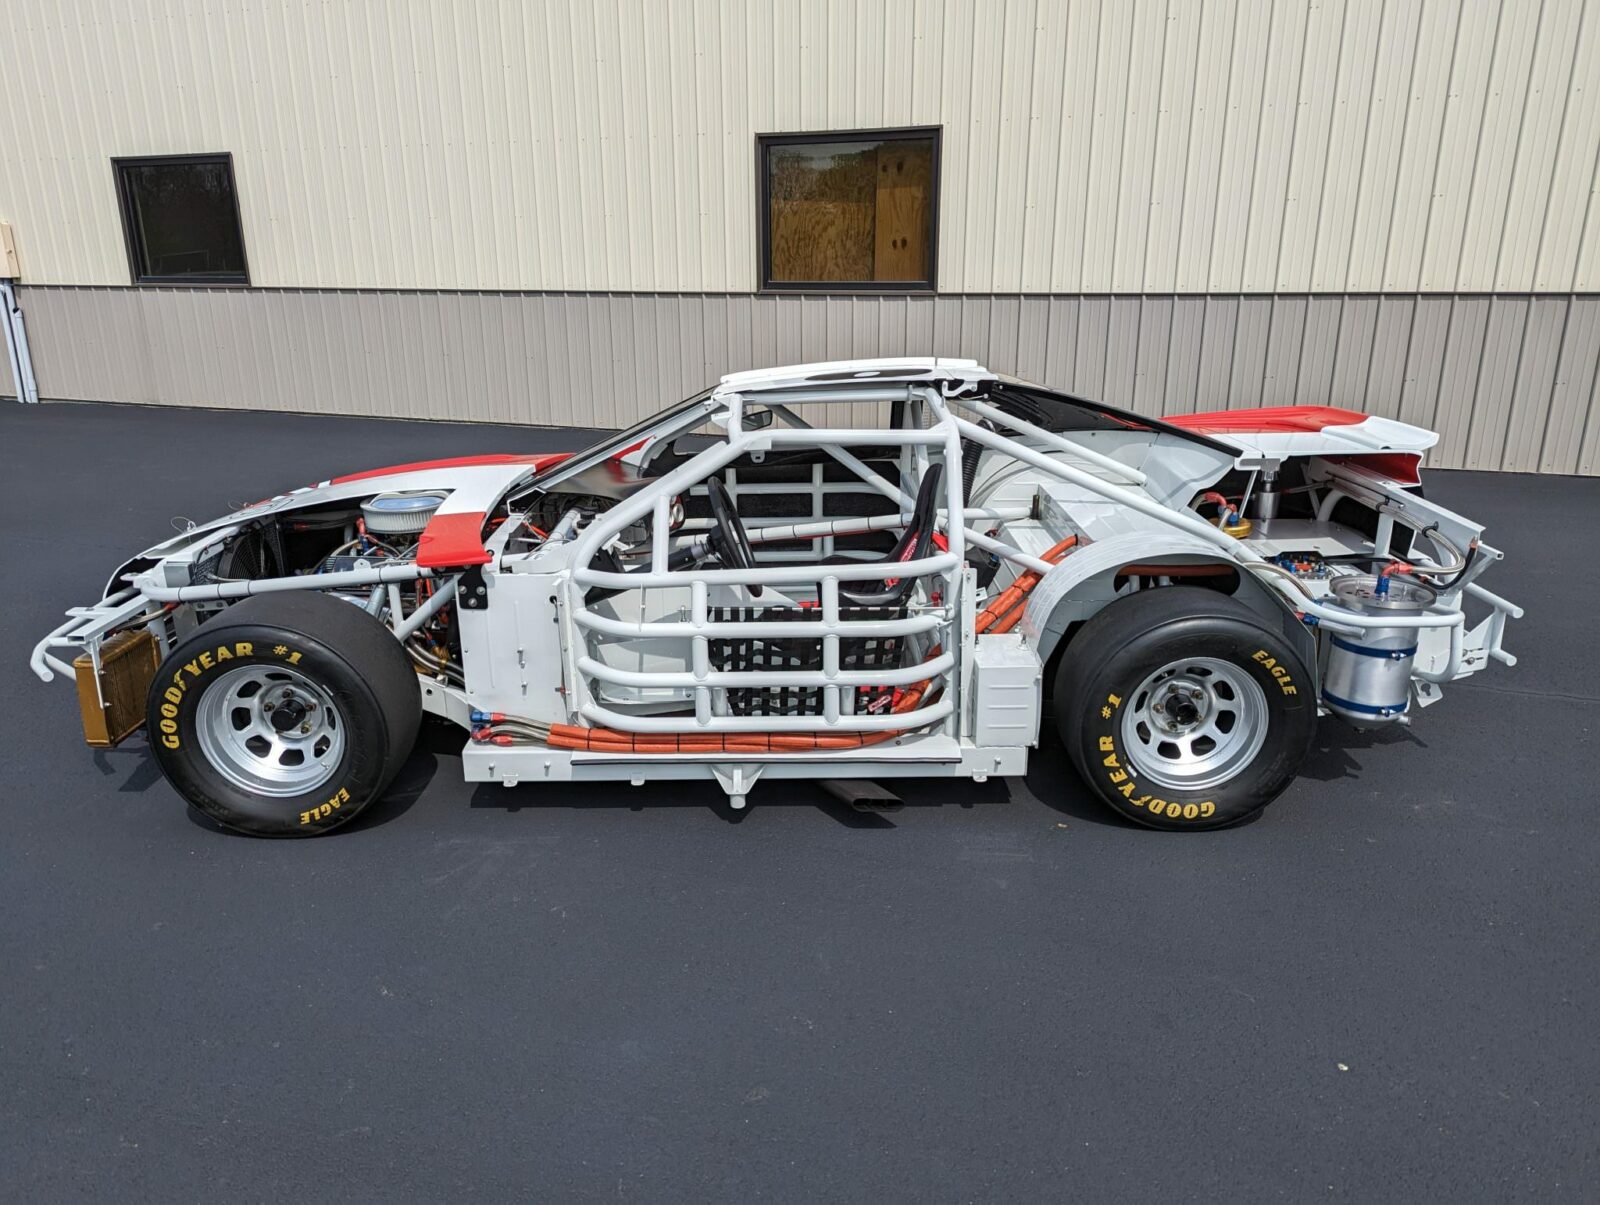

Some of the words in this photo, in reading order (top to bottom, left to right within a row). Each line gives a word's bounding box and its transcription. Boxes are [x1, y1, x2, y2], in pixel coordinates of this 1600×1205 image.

[1251, 650, 1297, 695] EAGLE
[160, 642, 253, 749] GOODYEAR
[273, 645, 302, 665] #1
[1101, 693, 1122, 719] #1
[1099, 736, 1216, 819] GOODYEAR
[300, 787, 350, 825] EAGLE
